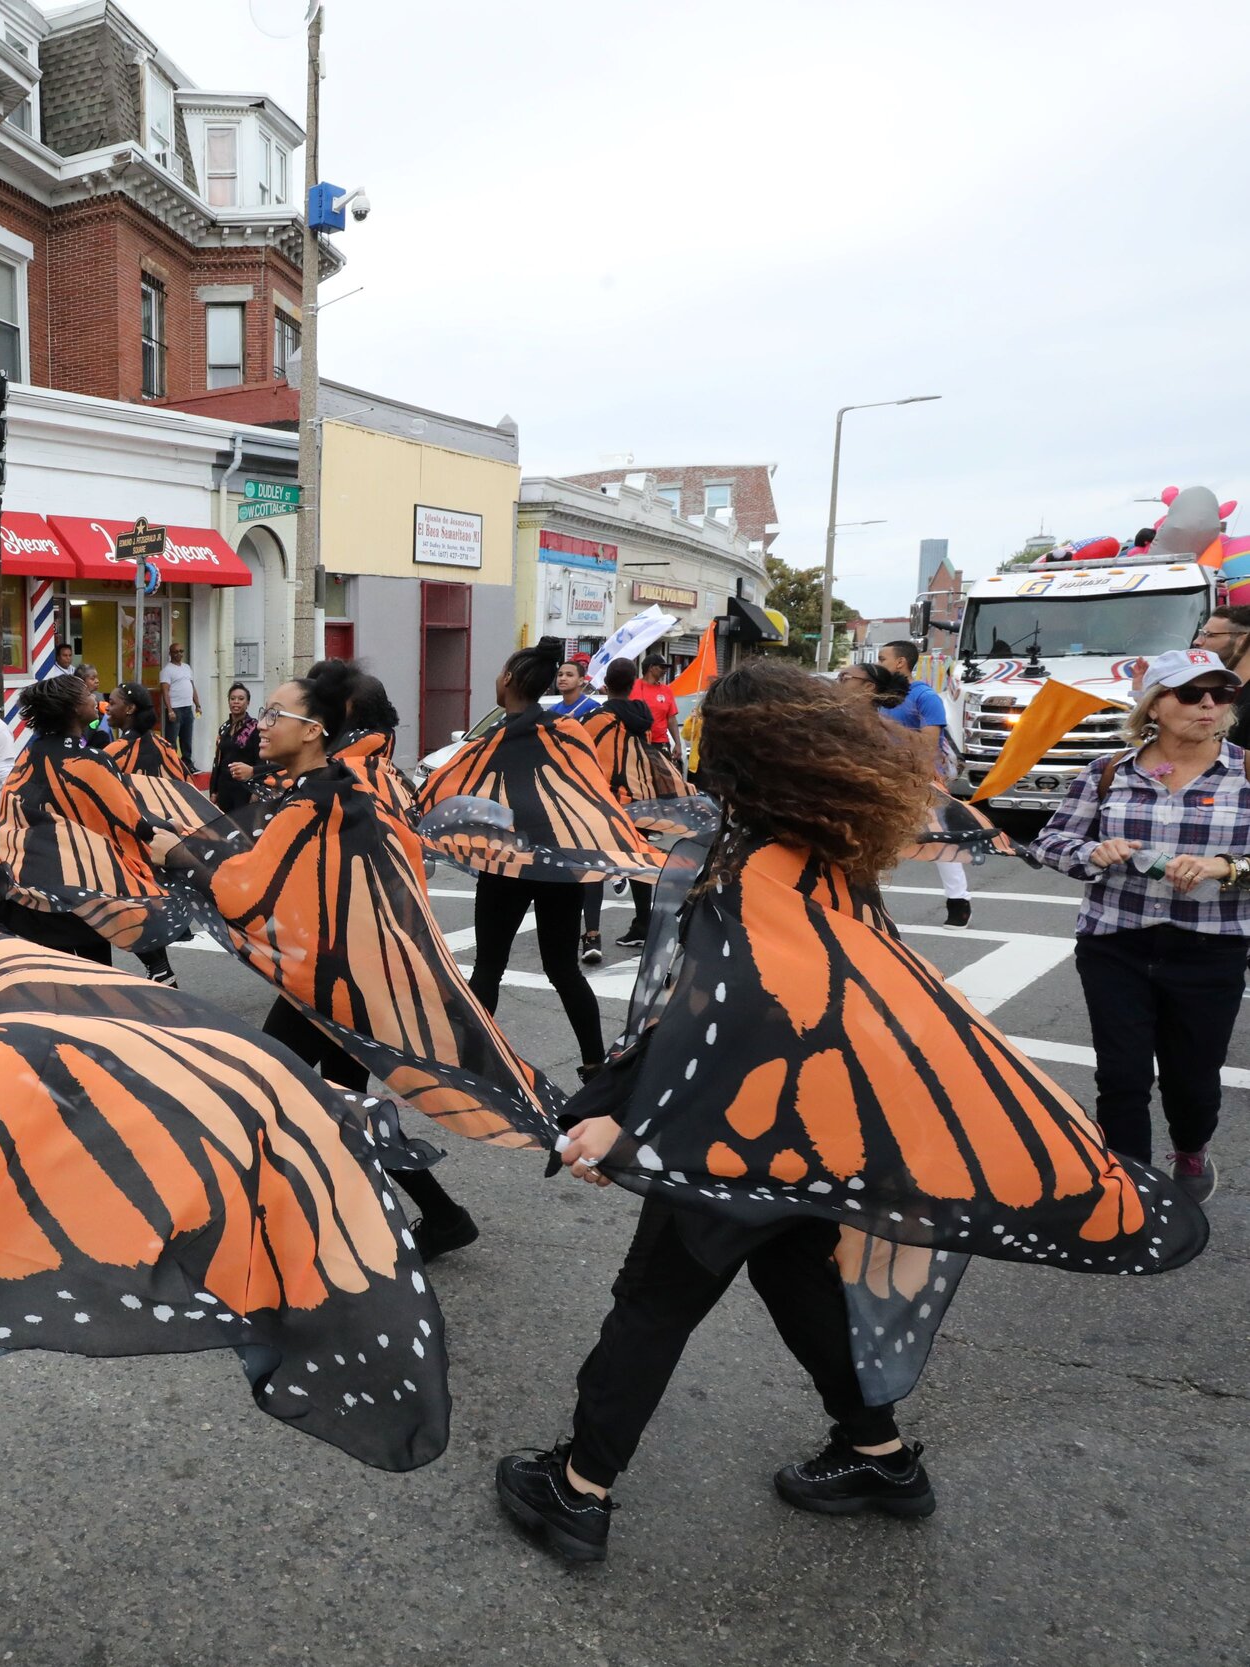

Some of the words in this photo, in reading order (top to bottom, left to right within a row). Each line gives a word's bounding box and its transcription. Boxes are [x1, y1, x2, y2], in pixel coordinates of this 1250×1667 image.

[258, 483, 284, 500] DUDLEY
[285, 491, 291, 501] ST
[418, 522, 424, 536] El
[0, 525, 60, 556] Shears
